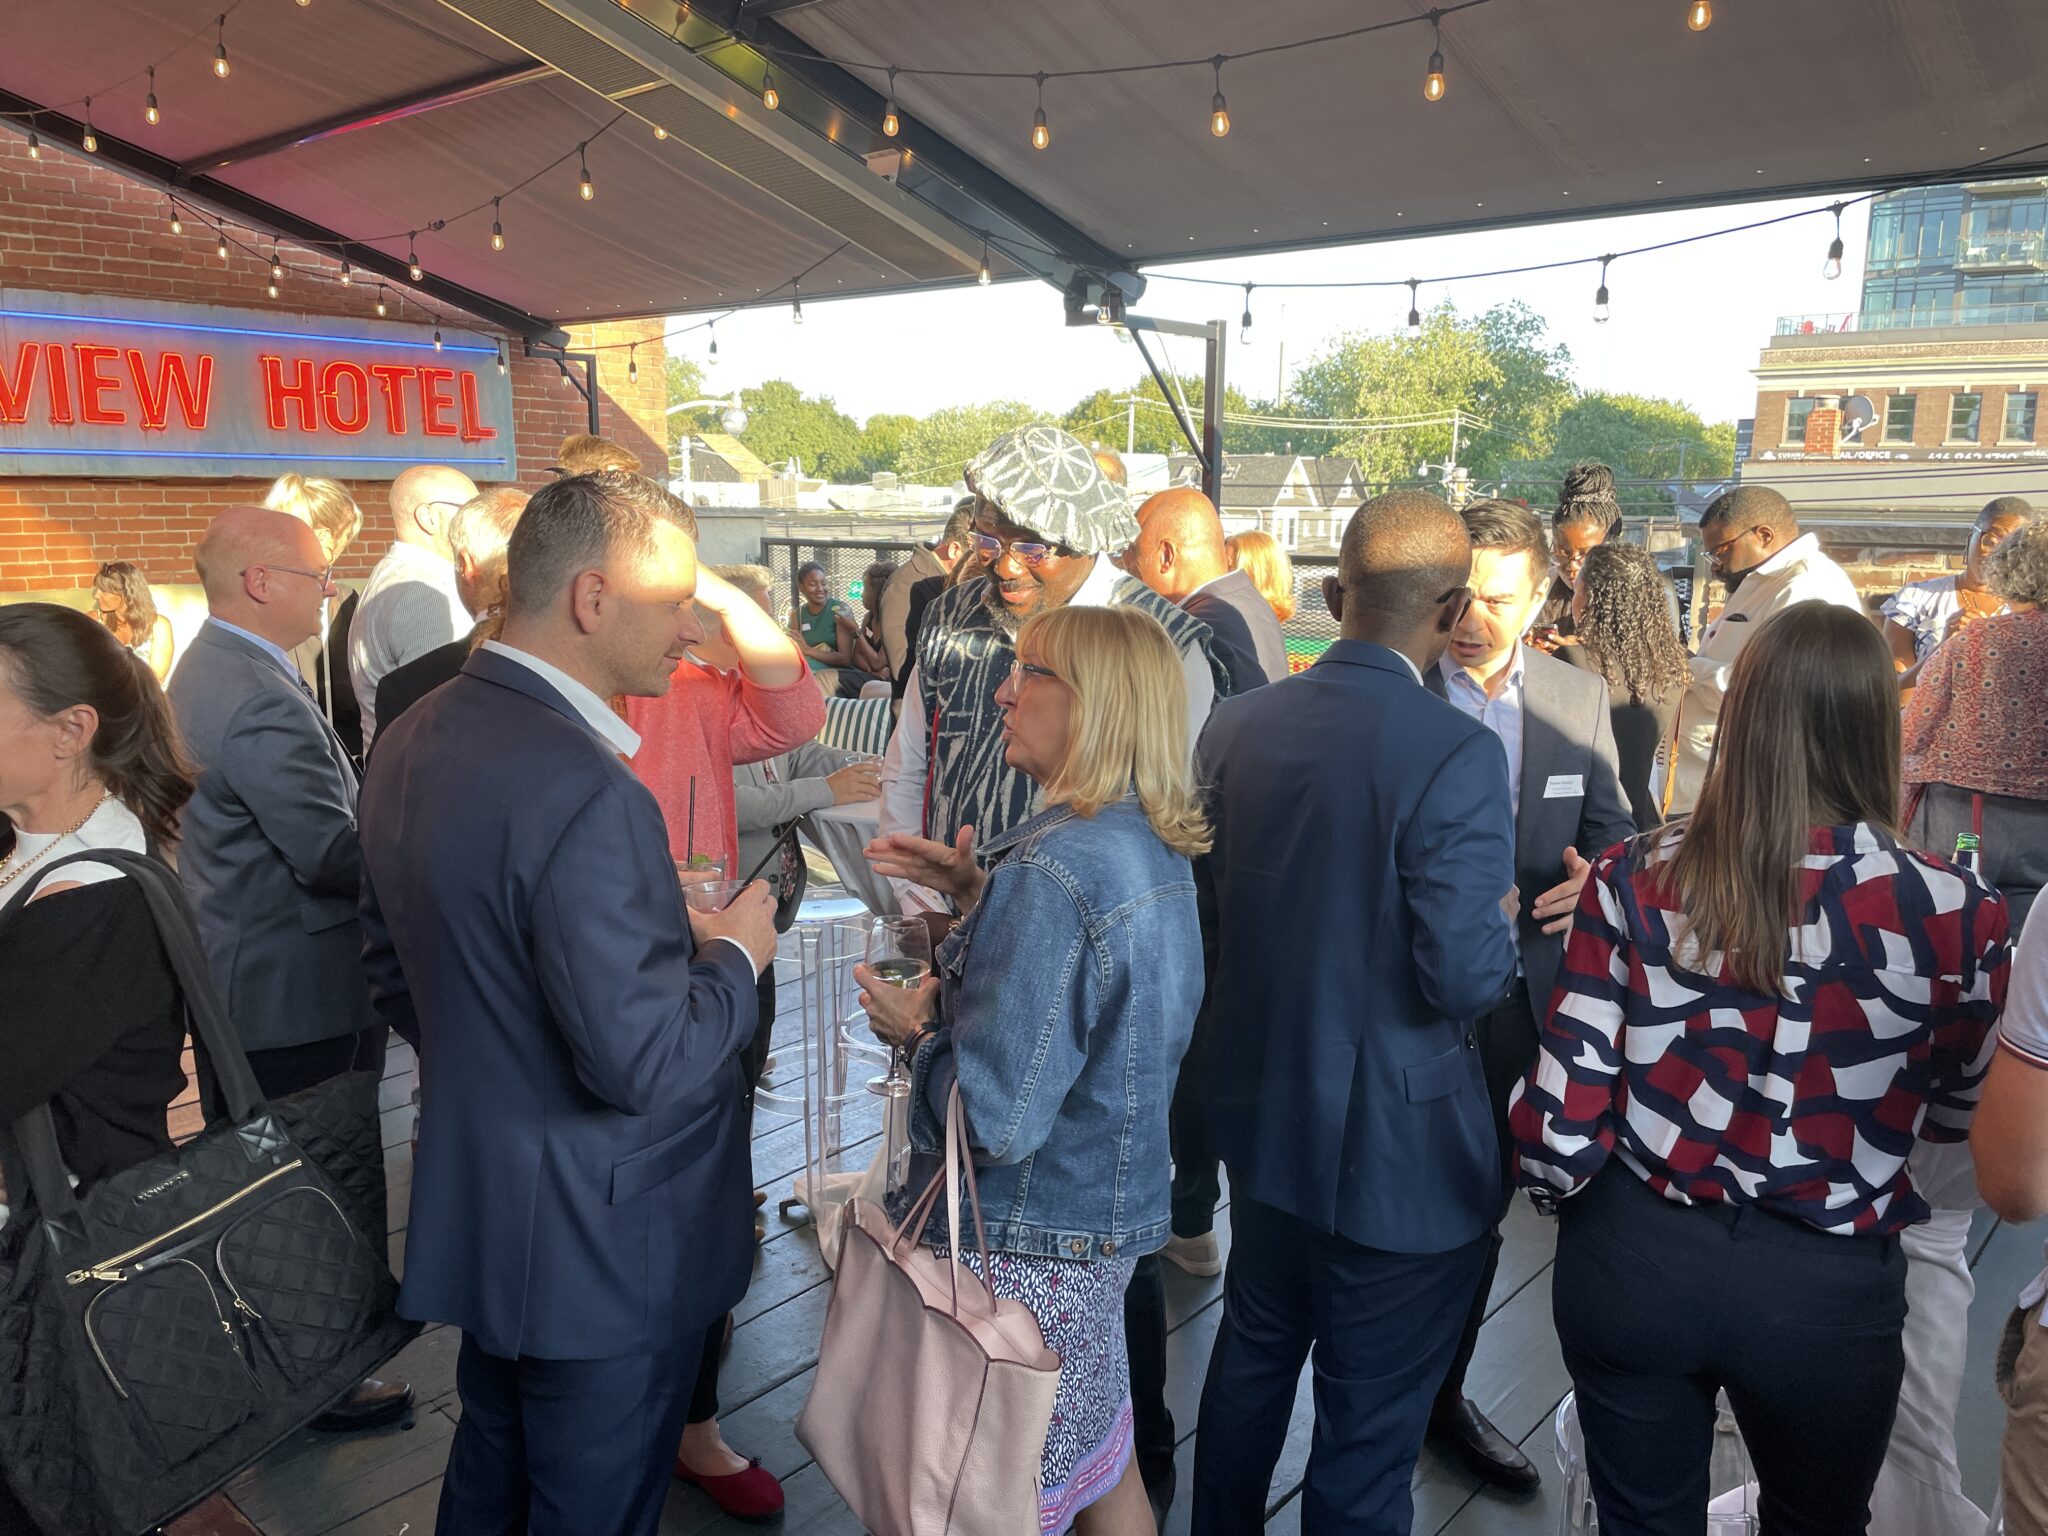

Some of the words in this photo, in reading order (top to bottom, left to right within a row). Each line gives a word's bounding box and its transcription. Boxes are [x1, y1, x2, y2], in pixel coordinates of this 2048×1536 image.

[0, 342, 215, 429] VIEW
[261, 355, 498, 439] HOTEL
[1839, 451, 1891, 460] AIL/OFFICE
